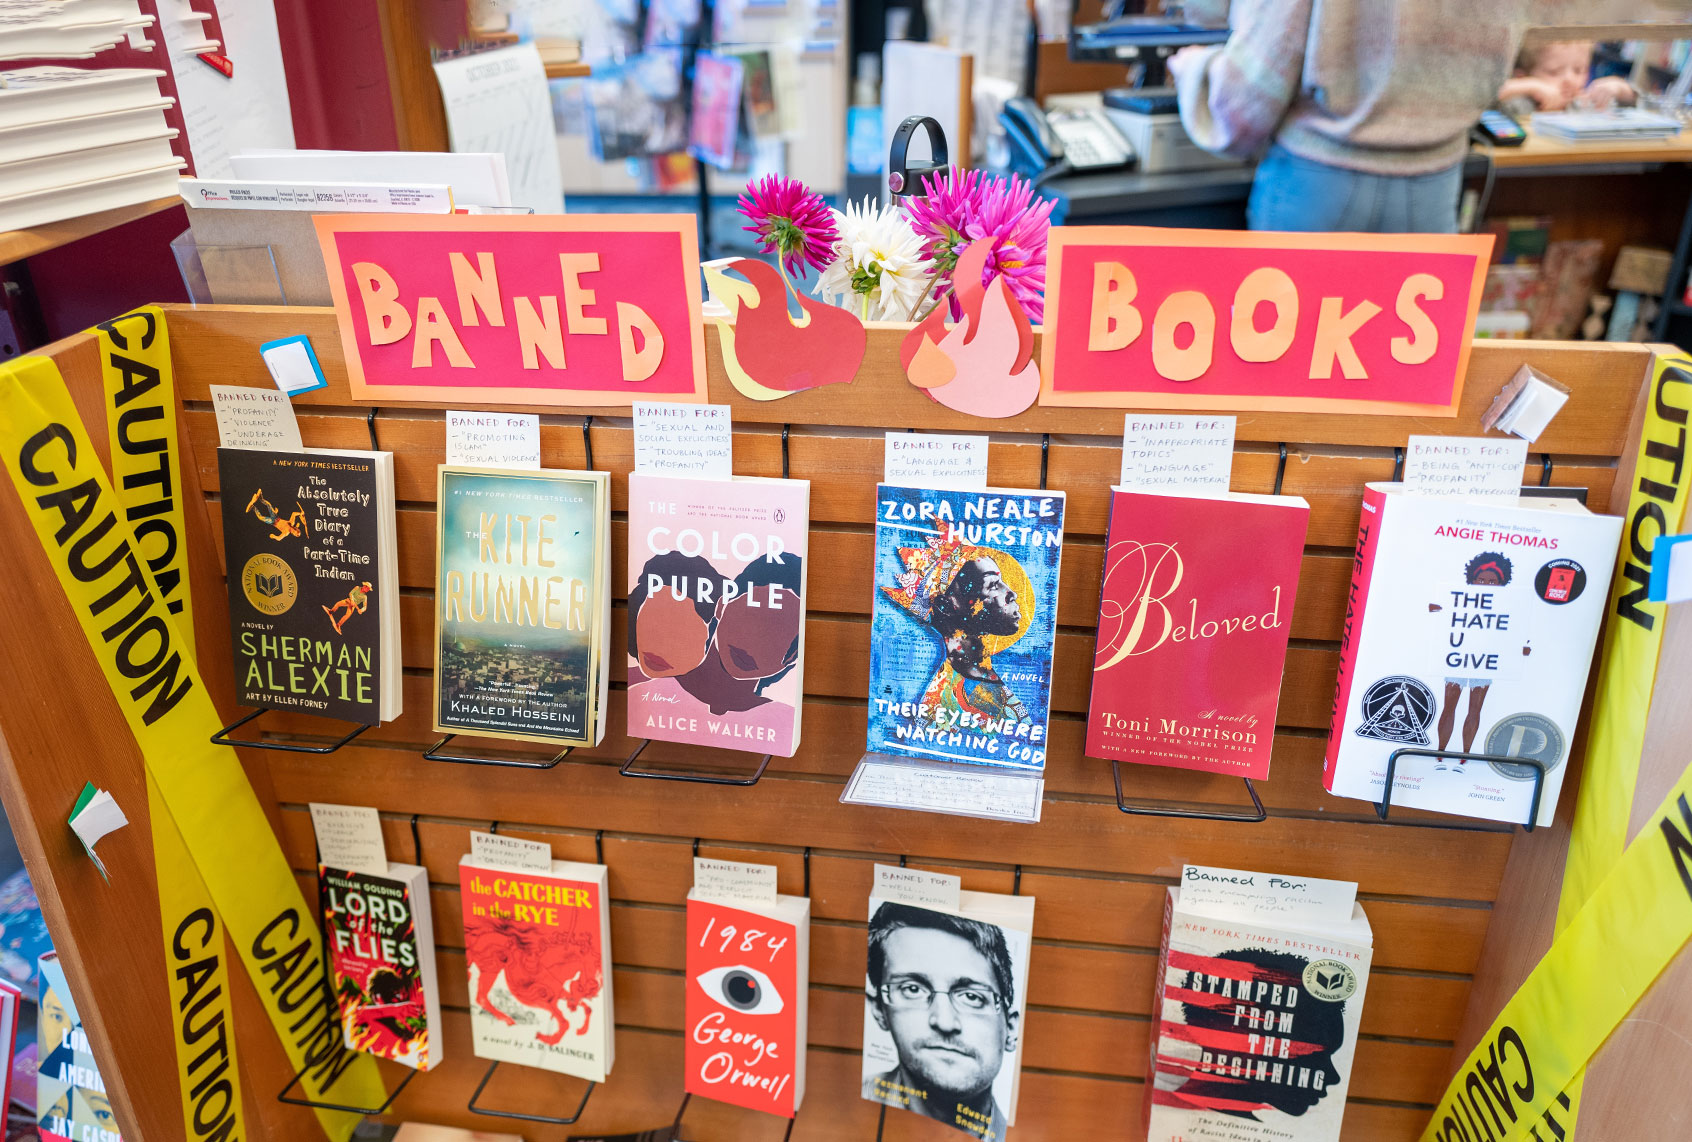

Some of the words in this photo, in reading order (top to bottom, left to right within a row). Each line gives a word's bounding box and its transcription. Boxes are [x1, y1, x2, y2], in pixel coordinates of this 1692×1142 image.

[352, 252, 665, 382] BANNED
[1088, 261, 1444, 382] BOOKS
[217, 393, 257, 402] BANNED
[451, 417, 500, 427] BANNED
[507, 418, 530, 427] FOR:
[638, 408, 687, 418] BANNED
[695, 409, 725, 418] FOR:
[651, 420, 698, 431] "SEXUAL
[638, 434, 672, 442] SOCIAL
[1132, 421, 1184, 432] BANNED
[1195, 421, 1225, 430] FOR:
[893, 441, 944, 450] BANNED
[952, 442, 976, 450] FOR:
[1415, 445, 1471, 455] BANNED
[1480, 446, 1510, 455] FOR:
[294, 460, 309, 468] YORK
[311, 461, 330, 470] TIMES
[331, 462, 369, 472] BESTSELLER
[1422, 461, 1460, 471] BEING
[309, 475, 327, 486] The
[297, 485, 370, 507] Absolutely
[1616, 358, 1692, 632] UTION
[316, 502, 349, 518] True
[648, 501, 677, 515] THE
[881, 499, 954, 521] ZORA
[964, 497, 1055, 520] NEALE
[314, 518, 351, 537] Diary
[466, 531, 487, 539] THE
[480, 512, 557, 568] KITE
[947, 521, 1062, 547] HURSTON
[1434, 525, 1485, 541] ANGIE
[1489, 531, 1559, 550] THOMAS
[322, 535, 335, 546] of
[337, 538, 344, 546] a
[647, 526, 786, 565] COLOR
[1353, 524, 1369, 576] THE
[303, 546, 370, 565] Part-Time
[19, 422, 193, 727] CAUTION
[314, 564, 356, 581] Indian
[446, 570, 587, 632] RUNNER
[647, 573, 784, 610] PURPLE
[1450, 590, 1494, 610] THE
[1093, 540, 1283, 671] Beloved
[1341, 585, 1360, 651] HATE
[246, 622, 266, 630] NOVEL
[1451, 611, 1510, 632] HATE
[241, 632, 371, 671] SHERMAN
[1449, 632, 1464, 648] U
[1445, 652, 1499, 671] GIVE
[245, 658, 373, 704] ALEXIE
[1001, 672, 1009, 682] A
[1011, 672, 1045, 683] NOVEL
[246, 692, 260, 701] ART
[262, 694, 272, 703] BY
[274, 695, 298, 705] ELLEN
[299, 698, 329, 710] FORNEY
[641, 691, 650, 702] A
[651, 692, 681, 704] Novel
[451, 700, 505, 716] KHALED
[512, 706, 575, 723] HOSSEINI
[874, 698, 929, 718] THEIR
[935, 707, 981, 728] EYES
[986, 717, 1044, 741] WERE
[1218, 713, 1245, 723] novel
[1246, 714, 1259, 729] by
[646, 714, 698, 732] ALICE
[707, 720, 776, 743] WALKER
[1102, 712, 1149, 732] Toni
[1158, 718, 1257, 744] Morrison
[896, 724, 999, 754] WATCHING
[1007, 741, 1045, 764] GOD
[1102, 730, 1140, 740] WINNER
[1163, 737, 1182, 745] THE
[1187, 740, 1218, 749] NOBEL
[1224, 744, 1254, 753] PRIZE
[327, 875, 360, 890] WILLIAM
[363, 883, 403, 898] GOLDING
[881, 871, 924, 883] BANNED
[1185, 867, 1254, 887] Banned
[1268, 878, 1307, 892] For:
[470, 875, 492, 896] the
[493, 878, 593, 910] CATCHER
[328, 887, 407, 924] LORD
[472, 901, 486, 917] in
[489, 901, 511, 920] the
[514, 903, 560, 927] RYE
[349, 918, 365, 933] of
[371, 921, 394, 936] the
[335, 929, 416, 968] FLIES
[699, 917, 788, 963] 1984
[1184, 922, 1209, 933] NEW
[1212, 928, 1241, 940] YORK
[1245, 933, 1280, 945] TIMES
[1285, 939, 1361, 961] BESTSELLER
[252, 907, 360, 1097] CAUTION
[1192, 971, 1299, 1008] STAMPED
[1233, 1005, 1294, 1034] FROM
[693, 1012, 780, 1066] George
[1248, 1033, 1291, 1060] THE
[700, 1051, 791, 1101] Orwell
[1201, 1051, 1326, 1092] BEGINNING
[1435, 1026, 1535, 1142] CAUTI
[956, 1103, 992, 1124] Edward
[49, 1114, 76, 1140] JAY
[955, 1114, 996, 1139] Snowden
